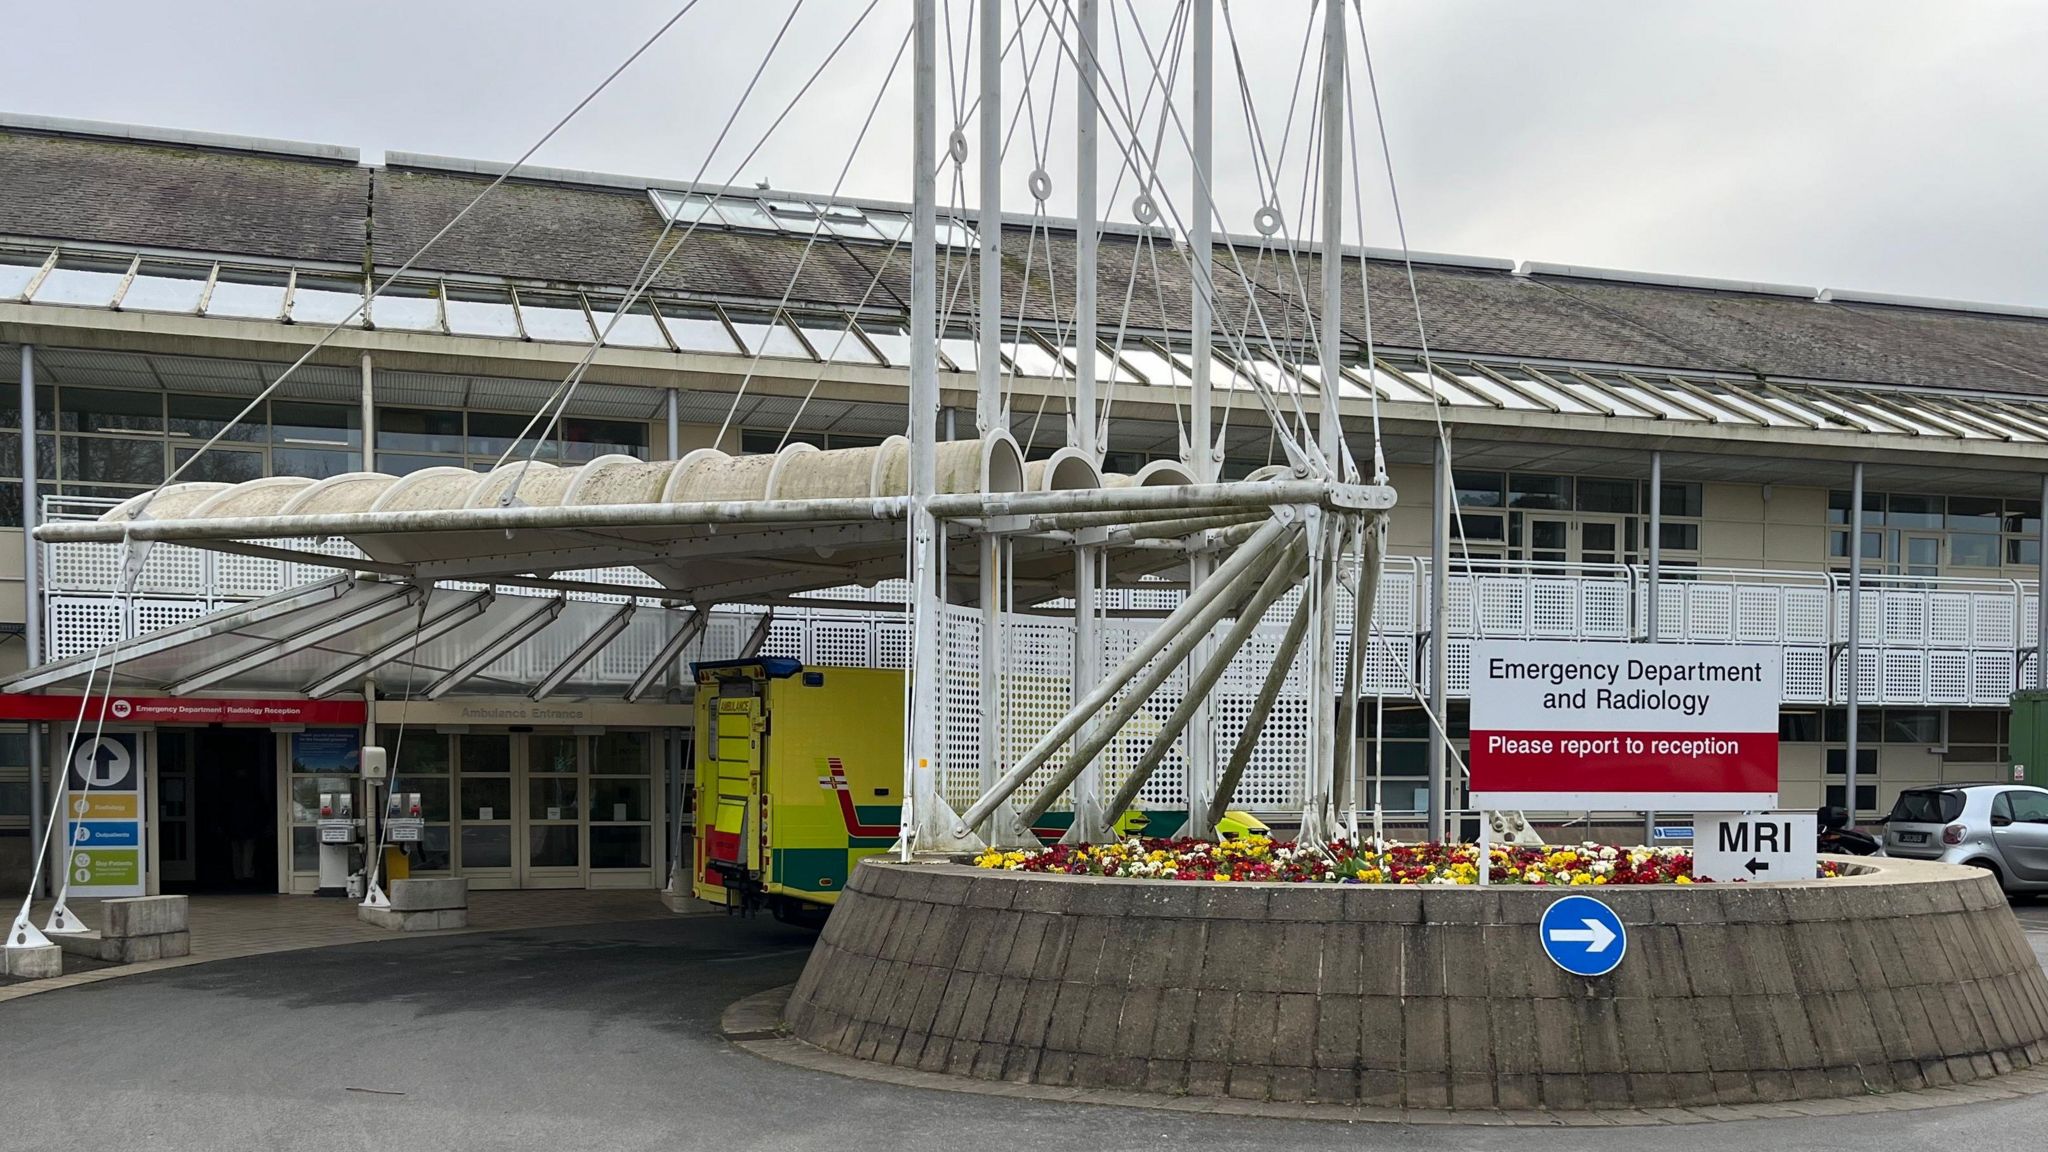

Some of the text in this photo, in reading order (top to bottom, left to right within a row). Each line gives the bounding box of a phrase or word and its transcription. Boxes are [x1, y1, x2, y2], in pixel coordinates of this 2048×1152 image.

[1489, 658, 1762, 686] Emergency Department
[136, 704, 301, 715] Emergency Department Radiology Reception
[462, 707, 583, 719] Ambulance Entrance
[721, 701, 750, 711] AMBULANCE
[1543, 689, 1709, 715] and Radiology
[1488, 736, 1739, 758] Please report to reception
[1718, 821, 1791, 853] MRI
